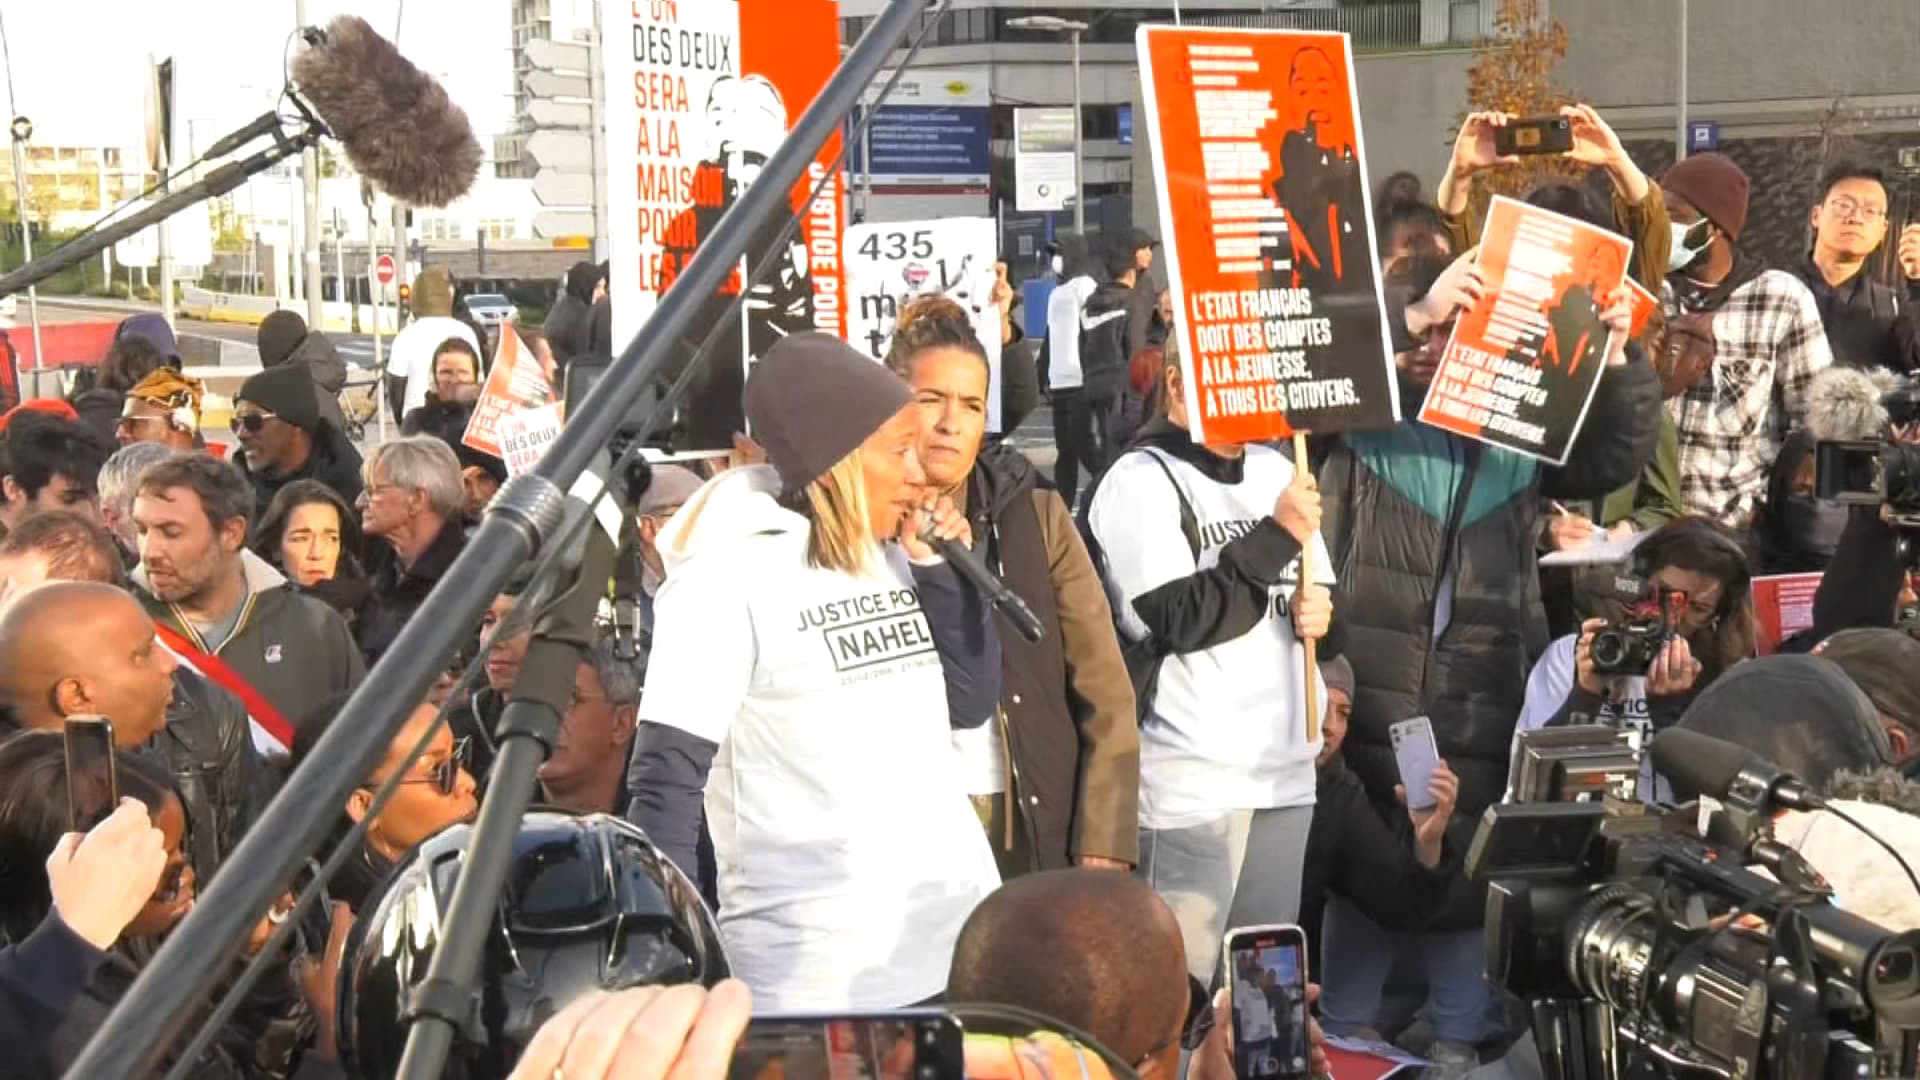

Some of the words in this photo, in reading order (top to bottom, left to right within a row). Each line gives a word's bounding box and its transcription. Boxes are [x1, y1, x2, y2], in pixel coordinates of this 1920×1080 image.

[633, 24, 672, 65] DES
[680, 29, 732, 72] DEUX
[635, 71, 689, 113] SERA
[637, 116, 651, 156] A
[657, 118, 681, 158] LA
[637, 161, 724, 208] MAISON
[638, 207, 697, 248] POUR
[858, 230, 933, 262] 435
[1240, 288, 1313, 321] FRANÇAIS
[1196, 324, 1232, 353] DOIT
[1233, 321, 1264, 350] DES
[1264, 318, 1332, 348] COMPTES
[1215, 355, 1233, 385] LA
[1235, 350, 1313, 382] JEUNESSE,
[1219, 387, 1257, 416] TOUS
[1259, 384, 1288, 414] LES
[1288, 378, 1361, 410] CITOYENS.
[797, 594, 887, 632] JUSTICE
[889, 586, 916, 610] PO
[837, 619, 930, 661] NAHEL
